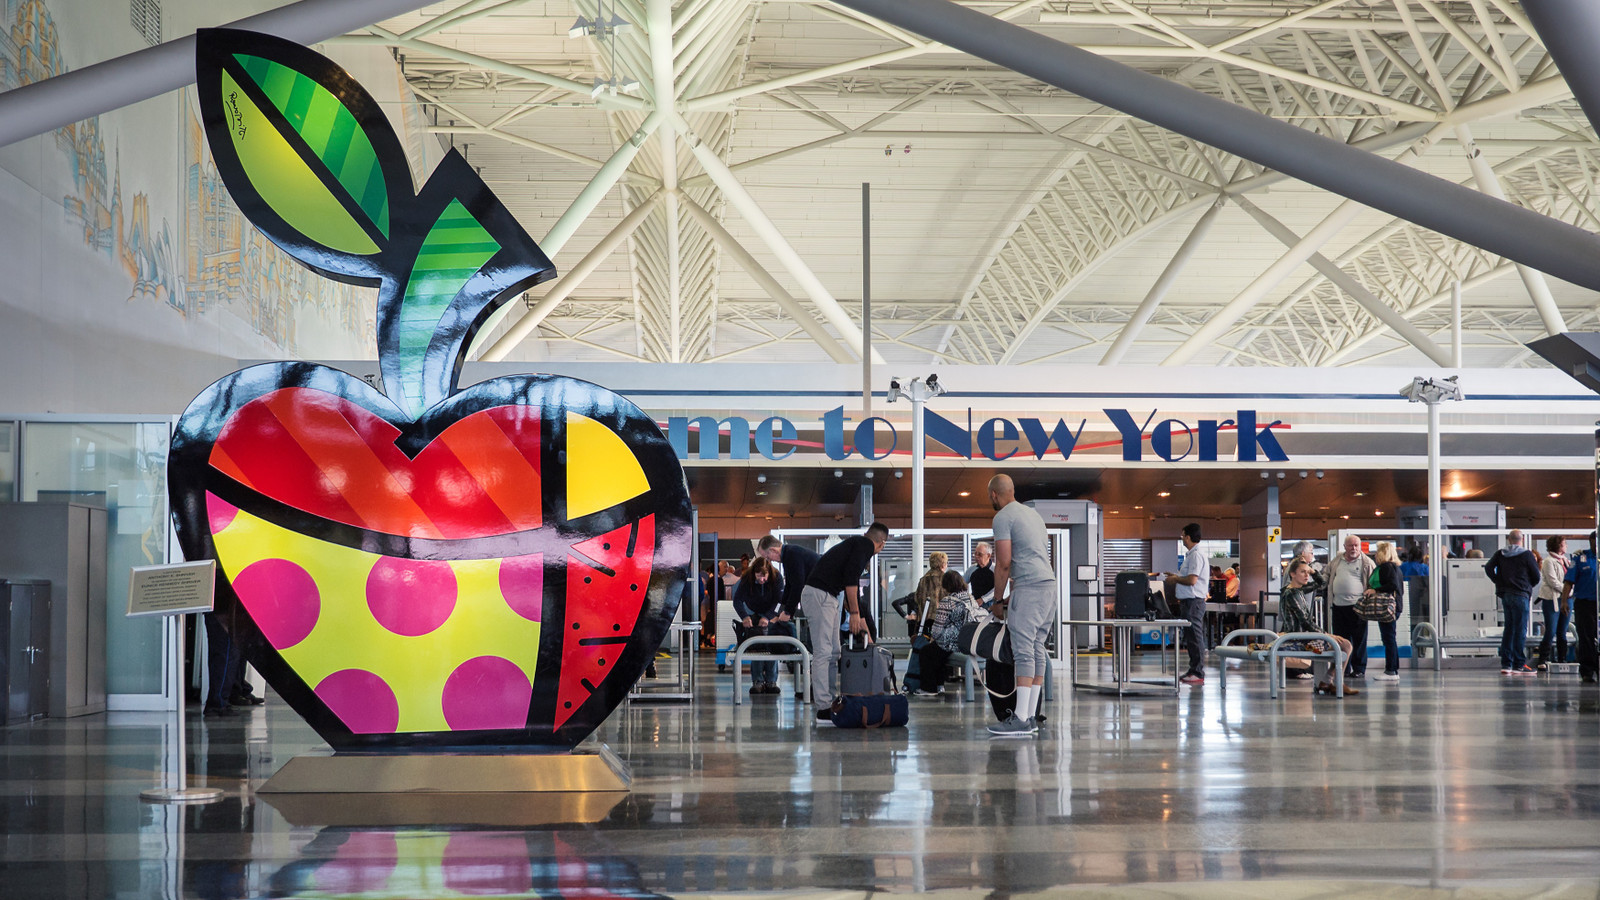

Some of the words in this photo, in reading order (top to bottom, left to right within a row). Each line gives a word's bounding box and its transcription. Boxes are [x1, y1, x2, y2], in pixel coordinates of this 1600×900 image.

[818, 405, 898, 460] to
[923, 407, 1087, 460] New
[1102, 408, 1290, 462] York
